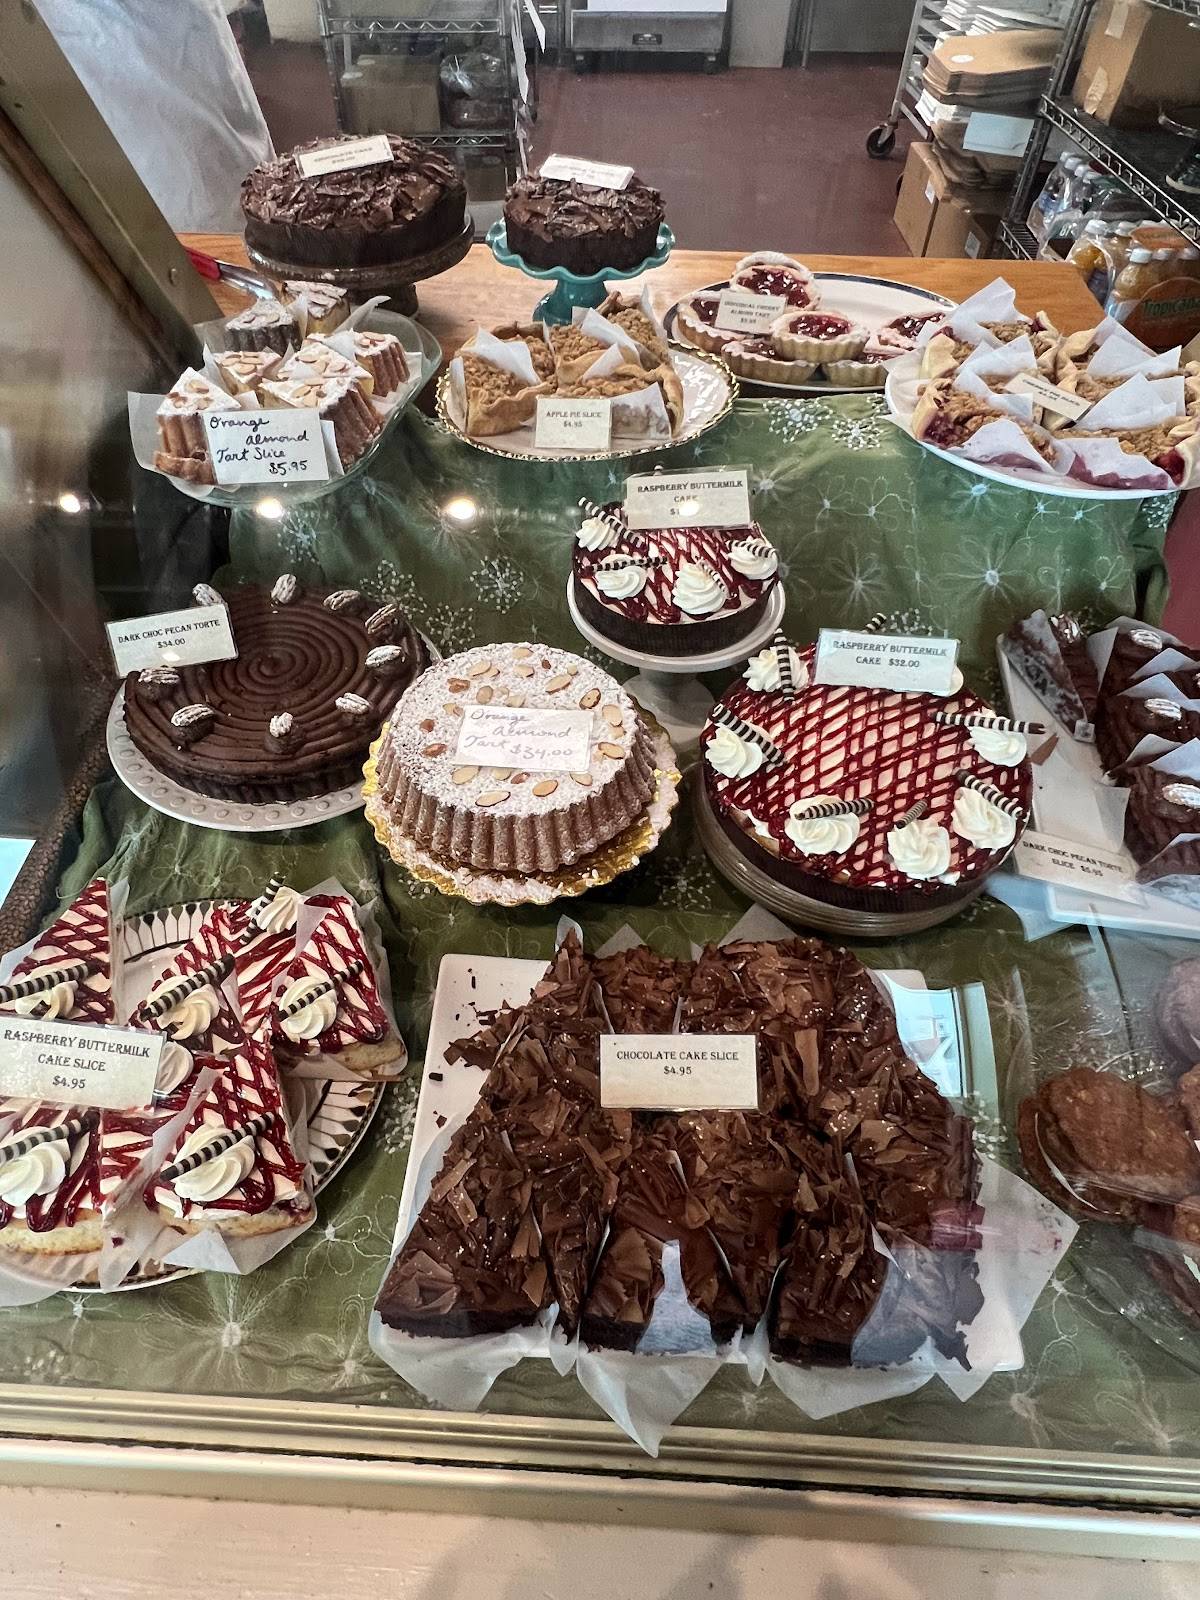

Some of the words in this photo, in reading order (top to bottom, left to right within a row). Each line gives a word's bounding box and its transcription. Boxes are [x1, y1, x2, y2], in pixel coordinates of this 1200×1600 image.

[209, 415, 270, 433] Orange
[216, 447, 250, 463] Tart
[253, 446, 286, 461] Slice
[268, 459, 308, 476] $5.95
[637, 482, 689, 493] RASPBERRY
[690, 480, 744, 490] BUTTERMILK
[118, 632, 141, 644] DARK
[142, 628, 164, 639] CHOC
[164, 623, 192, 635] PECAN
[193, 619, 221, 631] TORTE
[157, 637, 186, 649] $34.00
[832, 640, 889, 653] RASPBERRY
[889, 644, 948, 657] BUTTERMILK
[855, 655, 882, 666] CAKE
[888, 657, 921, 669] $32.00
[470, 708, 532, 727] Orange
[463, 734, 511, 749] Tart
[510, 743, 574, 760] $34.00
[1022, 840, 1047, 853] DARK
[1047, 847, 1070, 858] CHOC
[1070, 852, 1098, 866] PECAN
[1098, 860, 1123, 873] TORTE
[1051, 858, 1076, 870] SLICE
[3, 1028, 78, 1049] RASPBERRY
[78, 1038, 151, 1058] BUTTERMILK
[37, 1053, 72, 1067] CAKE
[73, 1058, 107, 1072] SLICE
[616, 1050, 677, 1061] CHOCOLATE
[679, 1050, 708, 1061] CAKE
[710, 1051, 740, 1061] SLICE
[663, 1065, 693, 1076] $4.95
[52, 1075, 87, 1089] $4.95
